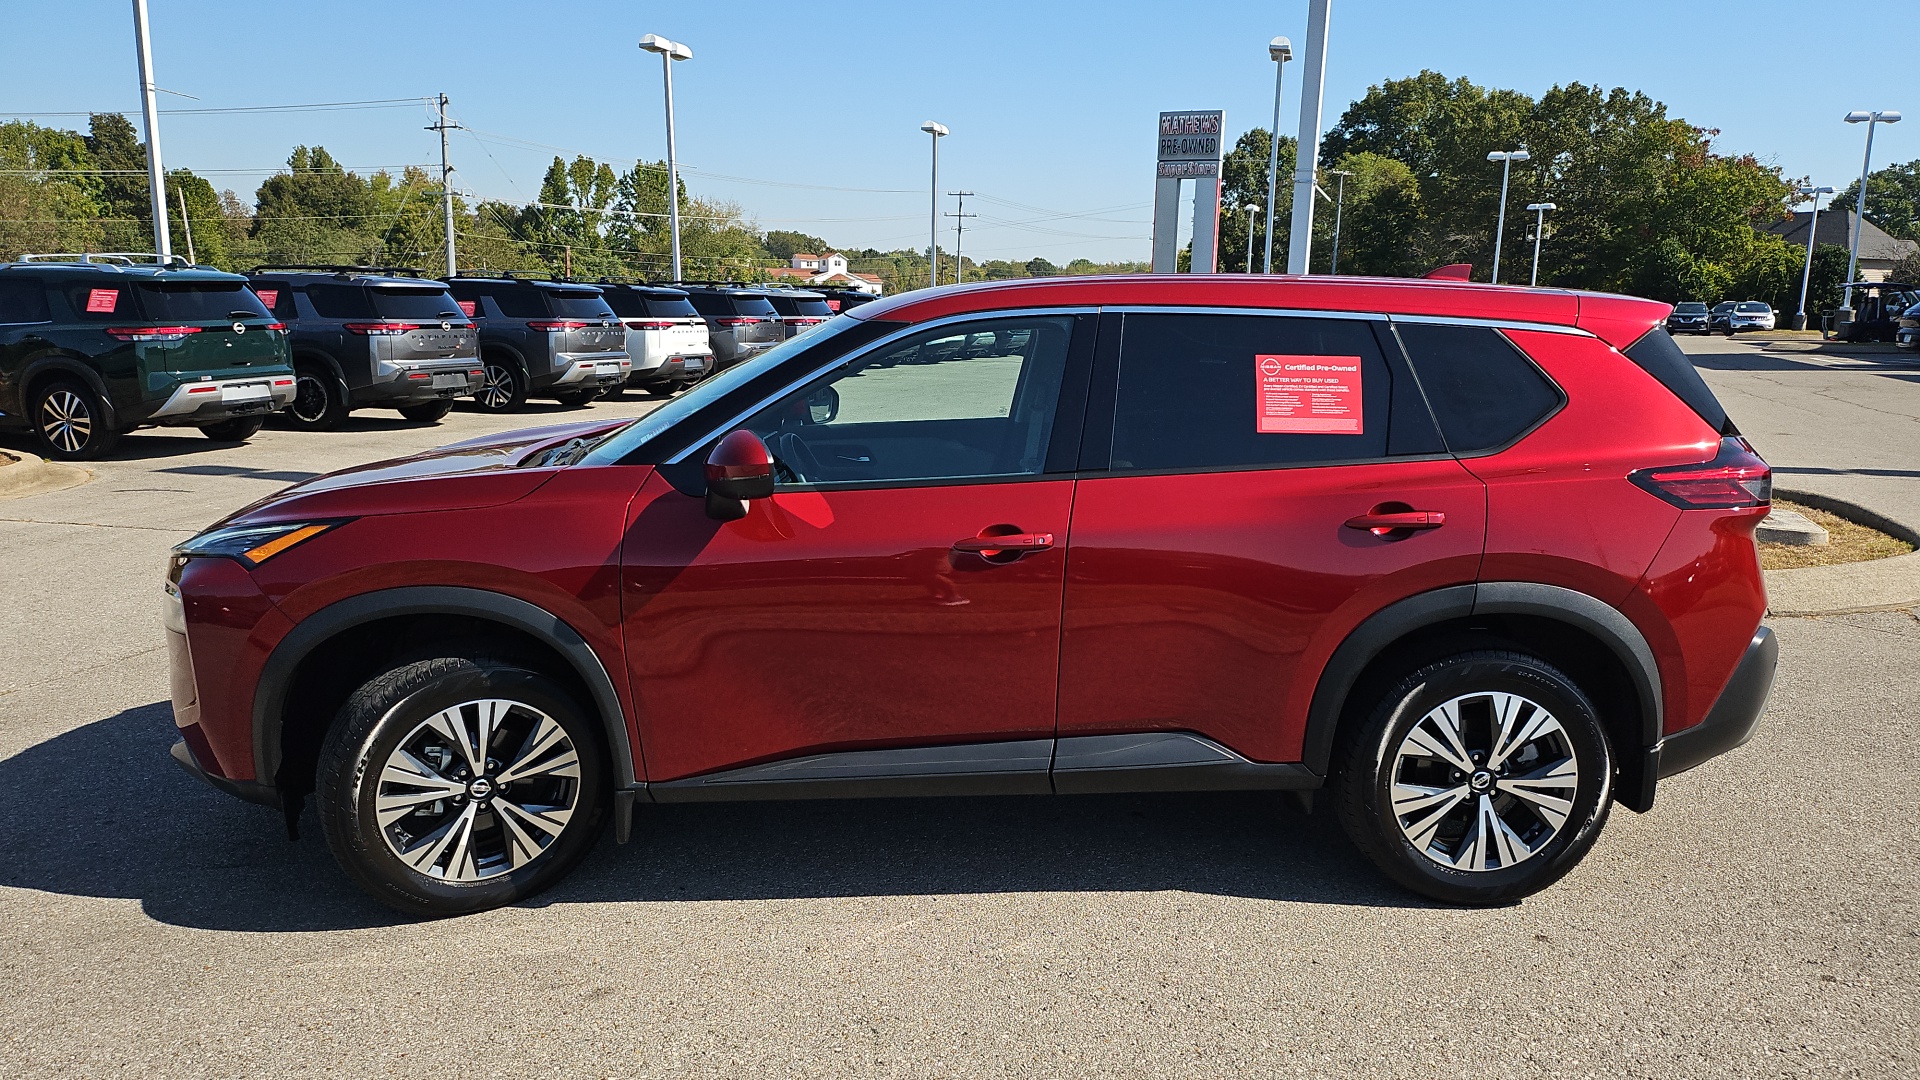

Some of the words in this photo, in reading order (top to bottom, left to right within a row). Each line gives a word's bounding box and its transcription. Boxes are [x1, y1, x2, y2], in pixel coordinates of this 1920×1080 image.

[1161, 115, 1219, 135] MATHEWS
[1160, 138, 1216, 155] PRE-OWNED
[1316, 364, 1357, 372] Pre-Owned
